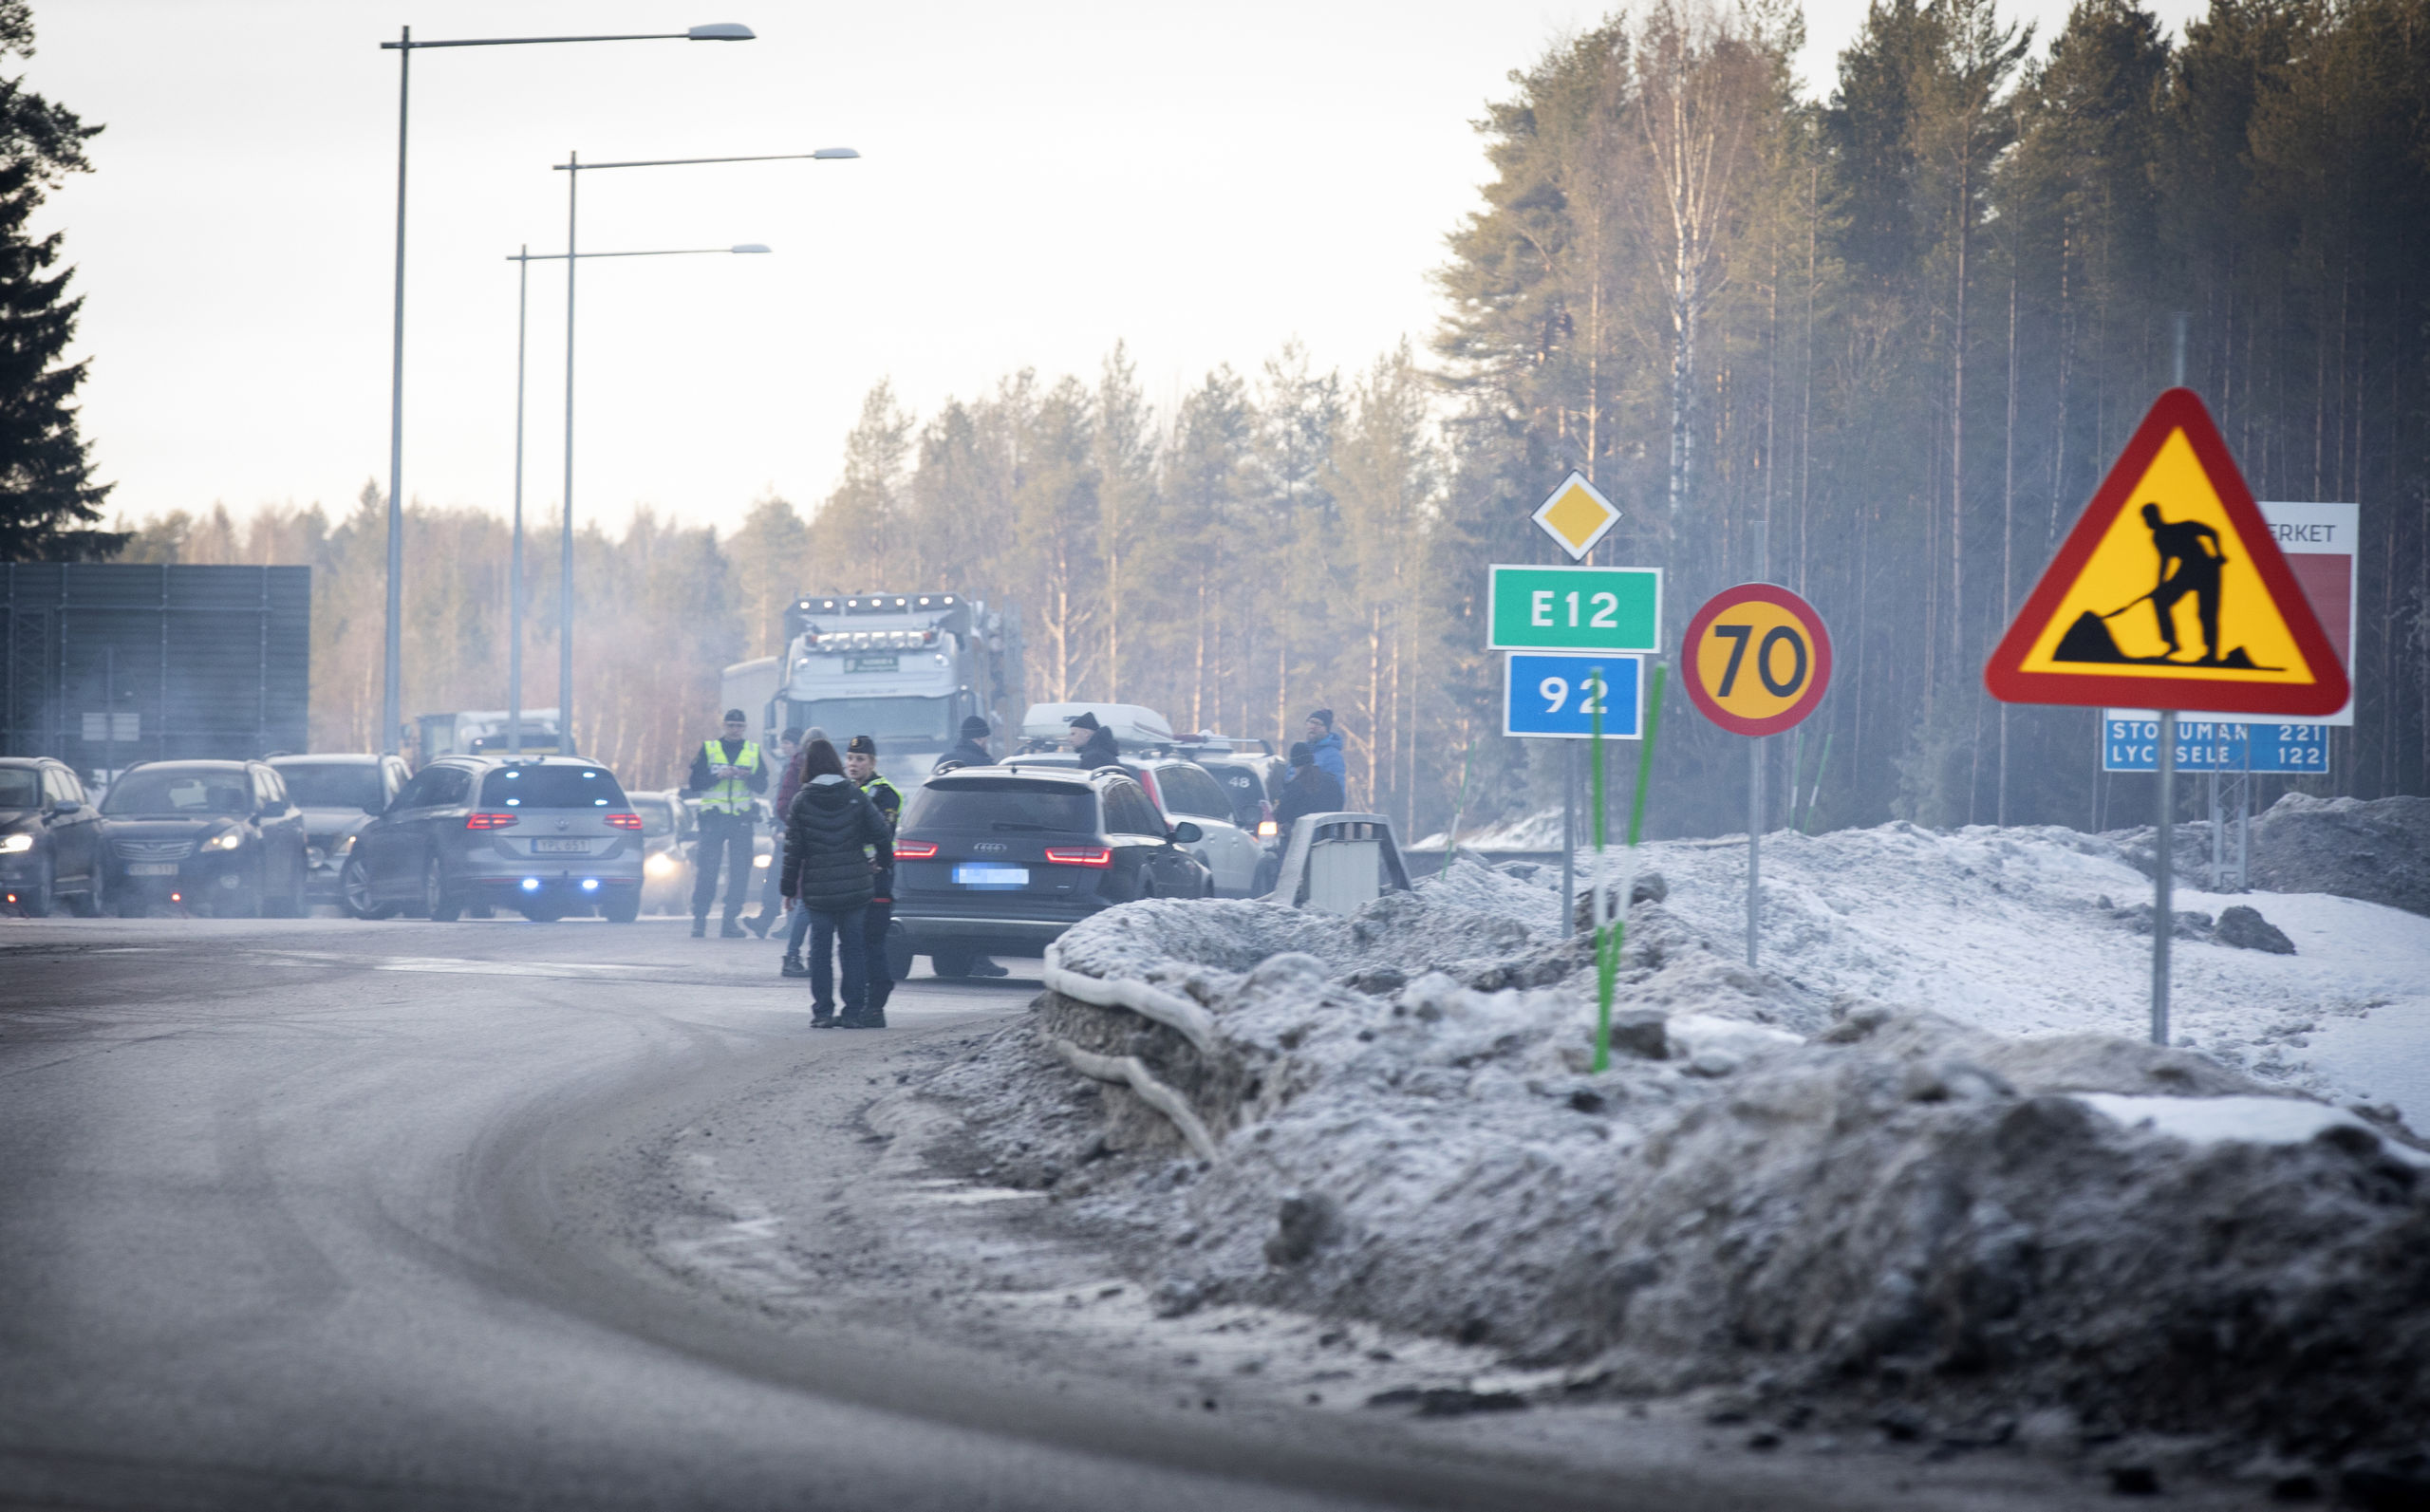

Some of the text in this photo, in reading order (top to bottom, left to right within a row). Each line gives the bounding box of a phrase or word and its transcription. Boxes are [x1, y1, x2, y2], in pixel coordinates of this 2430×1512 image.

[1531, 589, 1618, 627] E12
[1713, 625, 1807, 698] 70
[1539, 676, 1609, 714] 92
[2113, 722, 2320, 740] STOUMAN 221
[2113, 745, 2320, 764] LYCSELE 122
[1227, 776, 1250, 788] 48
